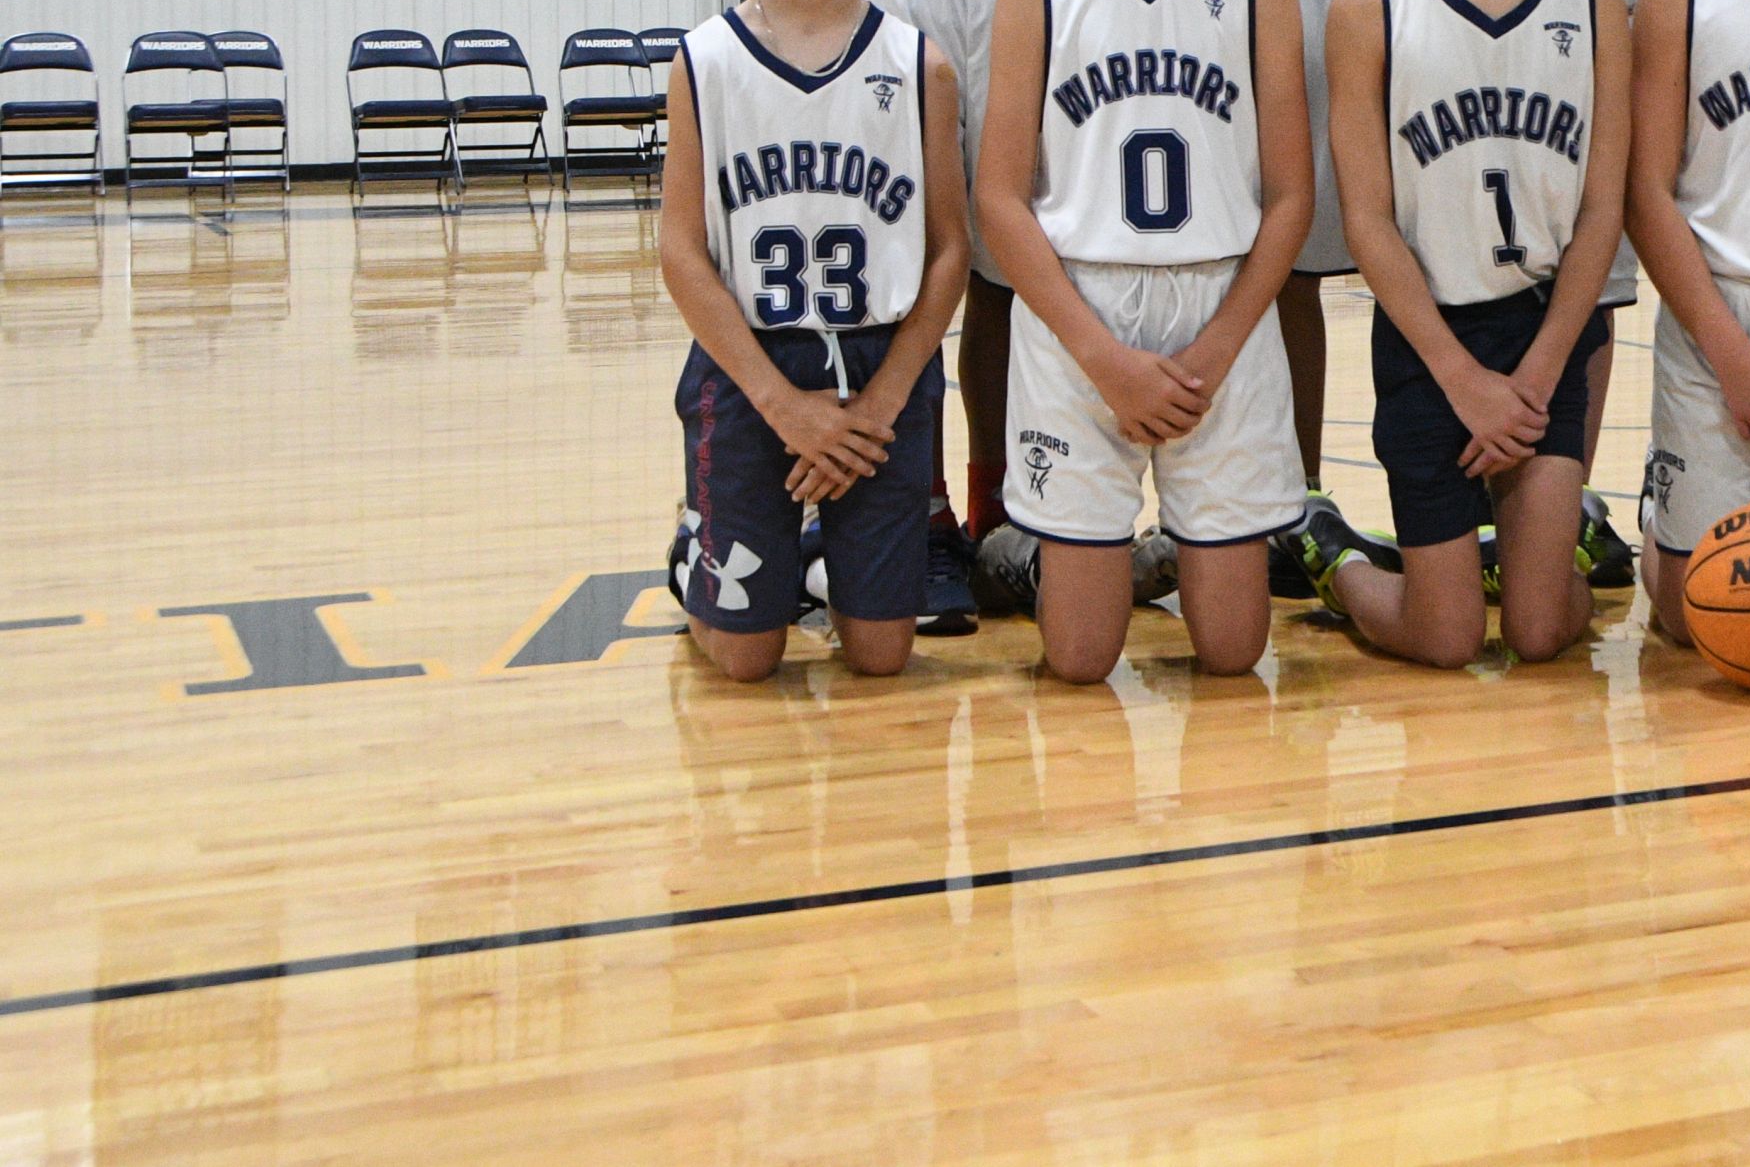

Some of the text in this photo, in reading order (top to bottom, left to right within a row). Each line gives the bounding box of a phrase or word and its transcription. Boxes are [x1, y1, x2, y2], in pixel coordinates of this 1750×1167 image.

[140, 41, 206, 51] WARRIORS
[362, 40, 423, 49] WARRIORS
[454, 39, 510, 48] WARRIORS
[575, 39, 634, 48] WARRIORS
[641, 38, 681, 47] WARRIO
[1053, 48, 1239, 128] WARRIORS
[1120, 128, 1192, 234] 0
[1482, 169, 1527, 266] 1
[751, 225, 870, 328] 33
[1019, 429, 1070, 458] WARRIORS
